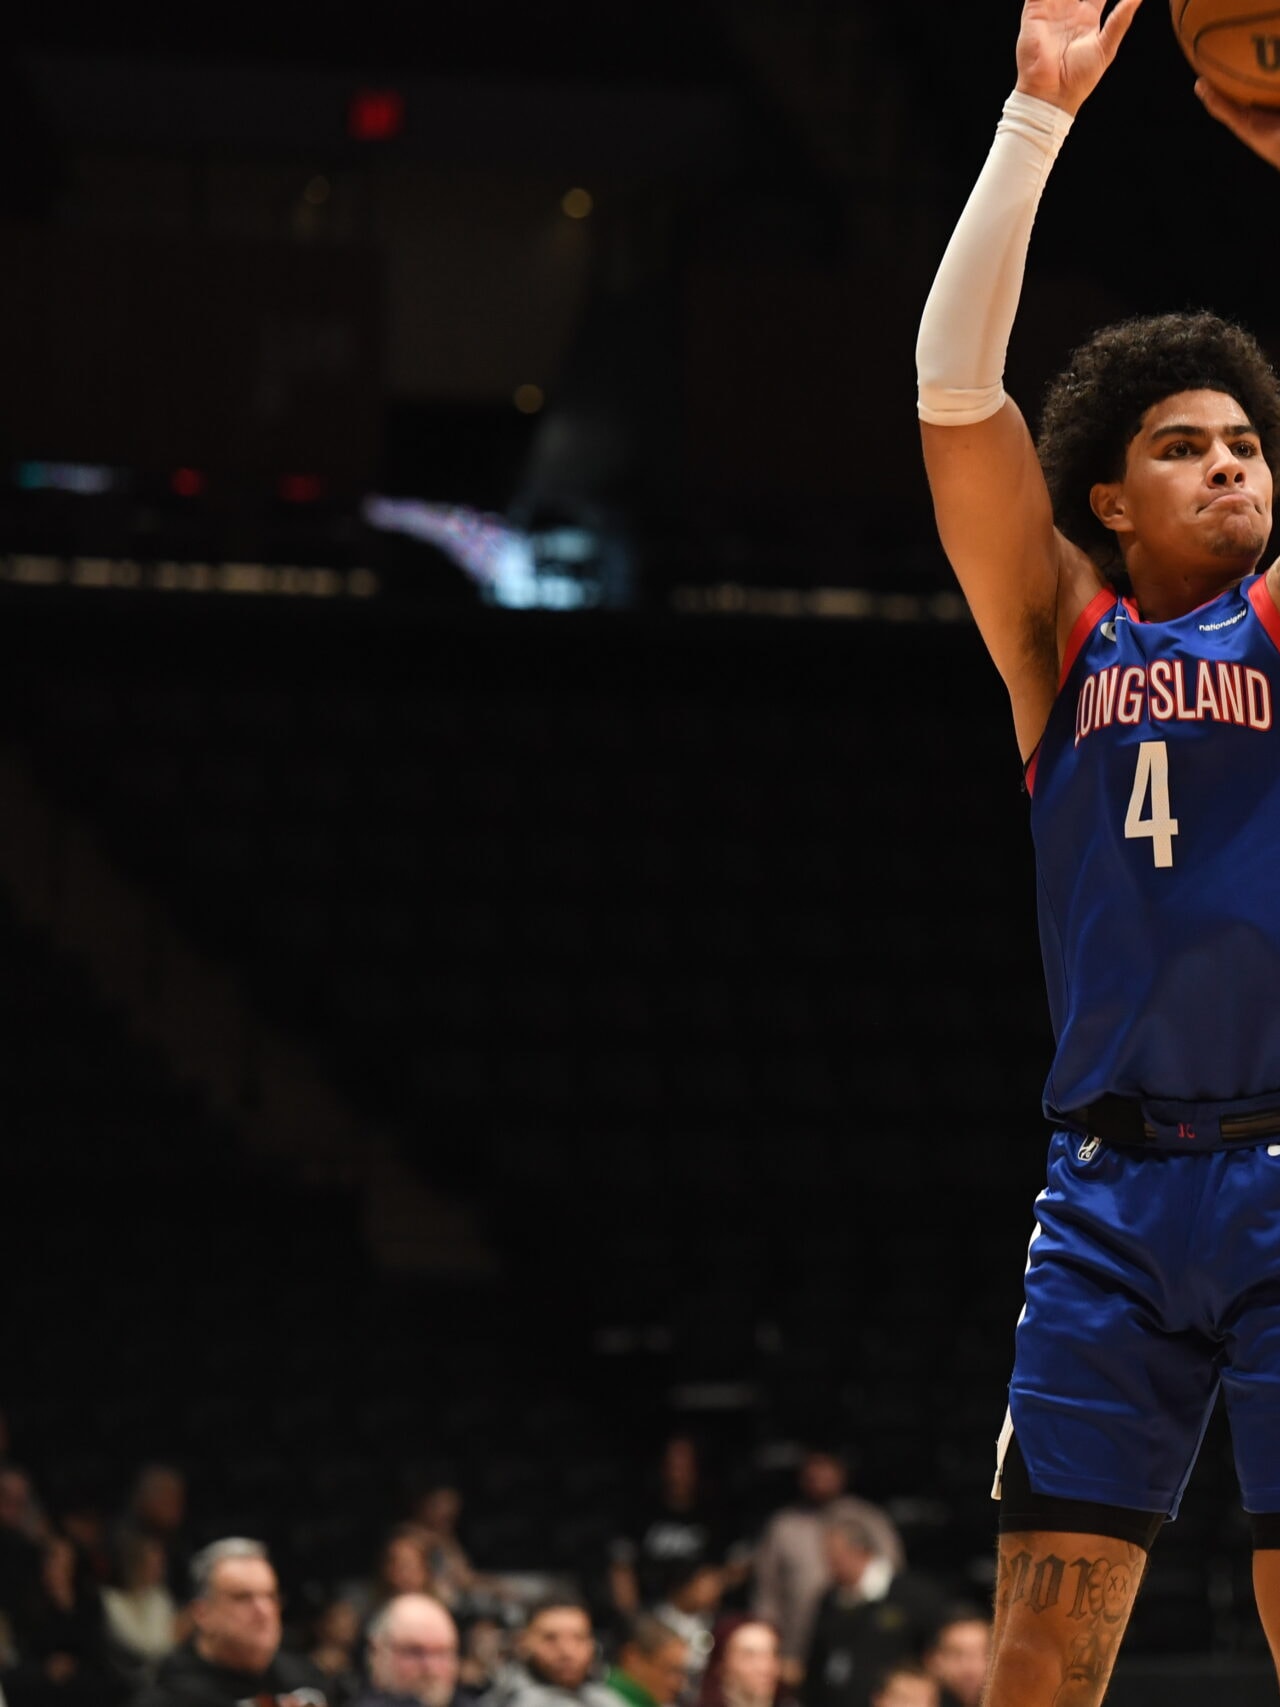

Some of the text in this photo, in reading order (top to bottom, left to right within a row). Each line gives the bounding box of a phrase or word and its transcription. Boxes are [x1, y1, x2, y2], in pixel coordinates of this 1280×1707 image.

[1073, 658, 1272, 749] ONG SLAND
[1124, 740, 1179, 868] 4
